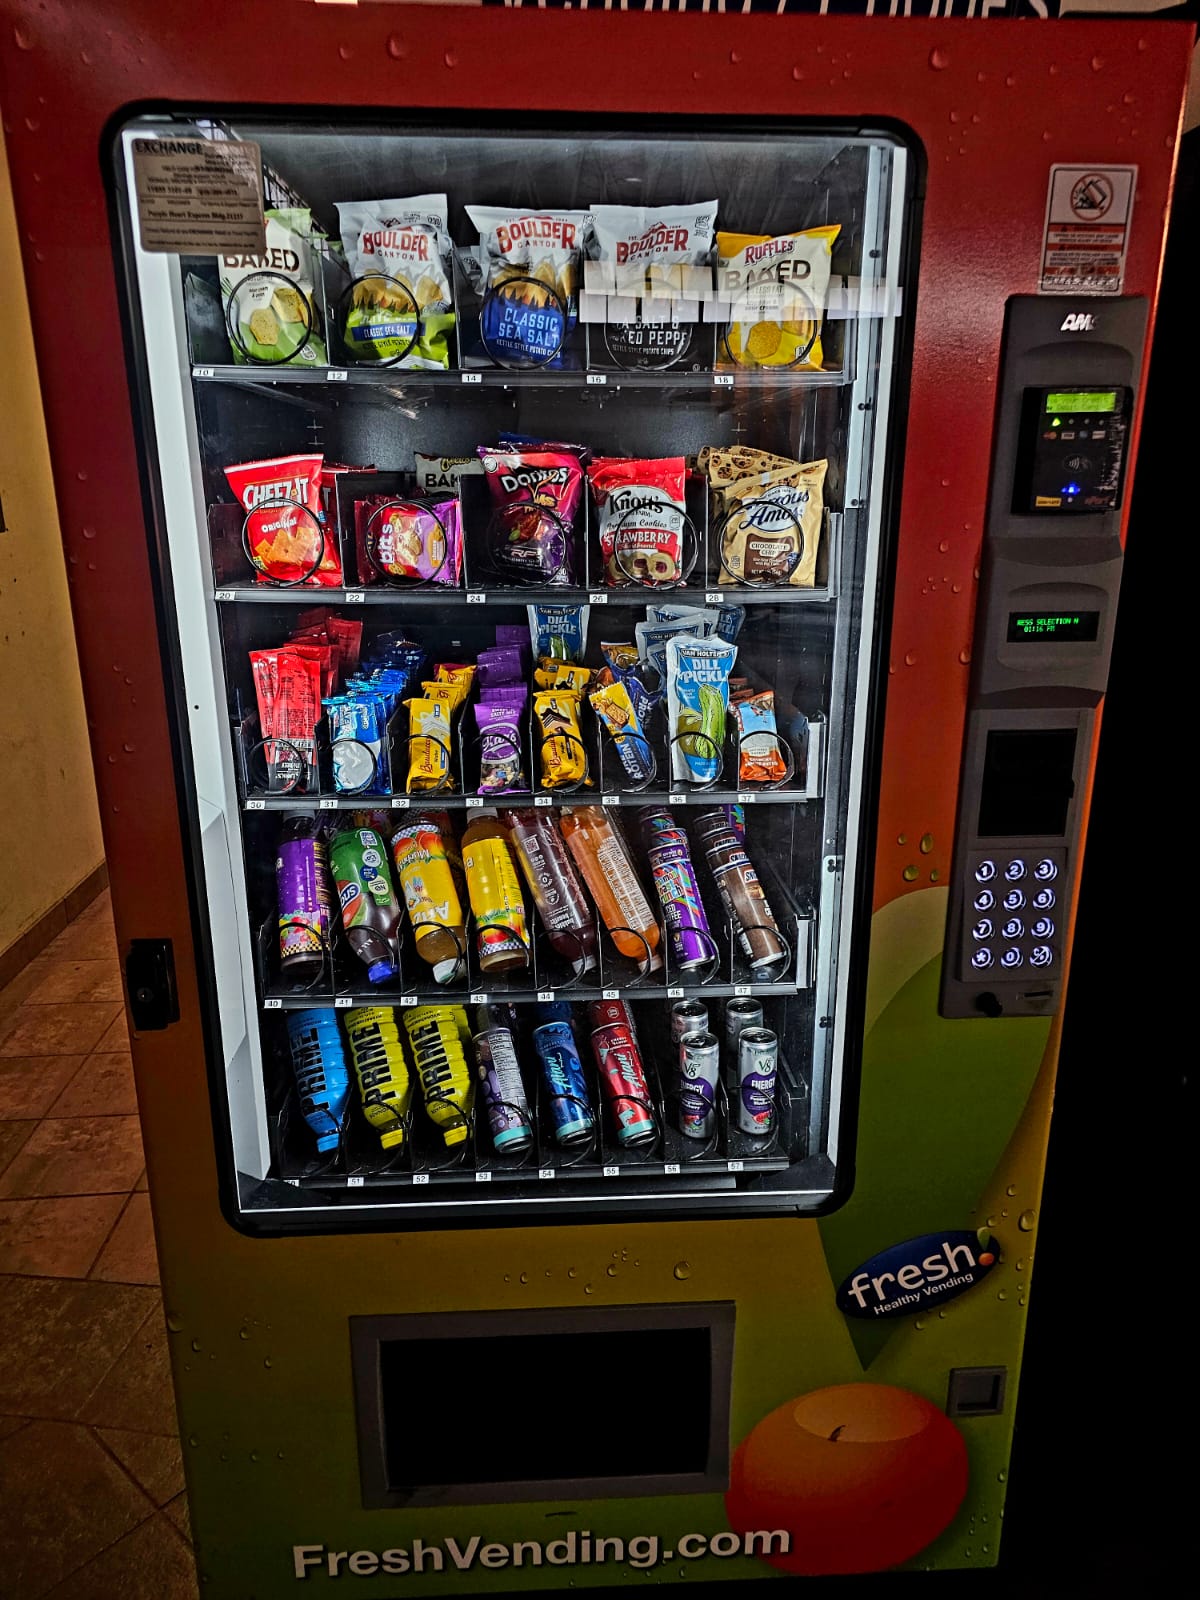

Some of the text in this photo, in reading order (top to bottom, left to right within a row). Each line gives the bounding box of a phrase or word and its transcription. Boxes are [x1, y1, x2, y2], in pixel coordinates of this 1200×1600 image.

[135, 142, 204, 155] EXCHANGE
[496, 221, 576, 253] BOULDER
[363, 232, 429, 261] BOULDER
[616, 229, 689, 266] BOULDER
[724, 259, 811, 290] BAKED
[504, 308, 559, 332] CLASSIC
[498, 322, 559, 348] SEA SALT
[514, 342, 529, 352] STYLE
[609, 490, 663, 516] Knott's
[640, 518, 667, 528] Cookies
[603, 531, 671, 546] STRAWBERRY
[548, 615, 569, 624] DILL
[1036, 617, 1071, 626] SELECTION
[539, 624, 576, 635] PICKLE
[692, 659, 721, 670] DILL
[679, 671, 729, 683] PICKL
[981, 866, 988, 877] 1
[1009, 865, 1018, 875] 2
[1039, 864, 1049, 874] 3
[979, 895, 987, 905] 4
[1009, 894, 1017, 904] 5
[1038, 893, 1046, 903] 6
[978, 923, 987, 934] 7
[1007, 923, 1016, 933] 8
[1036, 922, 1045, 932] 9
[1006, 951, 1014, 961] 0
[352, 1021, 397, 1108] PRIME
[412, 1020, 456, 1104] PRIME
[759, 1058, 772, 1072] V8
[684, 1063, 700, 1077] V8
[751, 1077, 776, 1090] ENERGY
[848, 1241, 976, 1308] fresh
[873, 1273, 974, 1315] Healthy Vending
[293, 1528, 790, 1579] FreshVending.com
